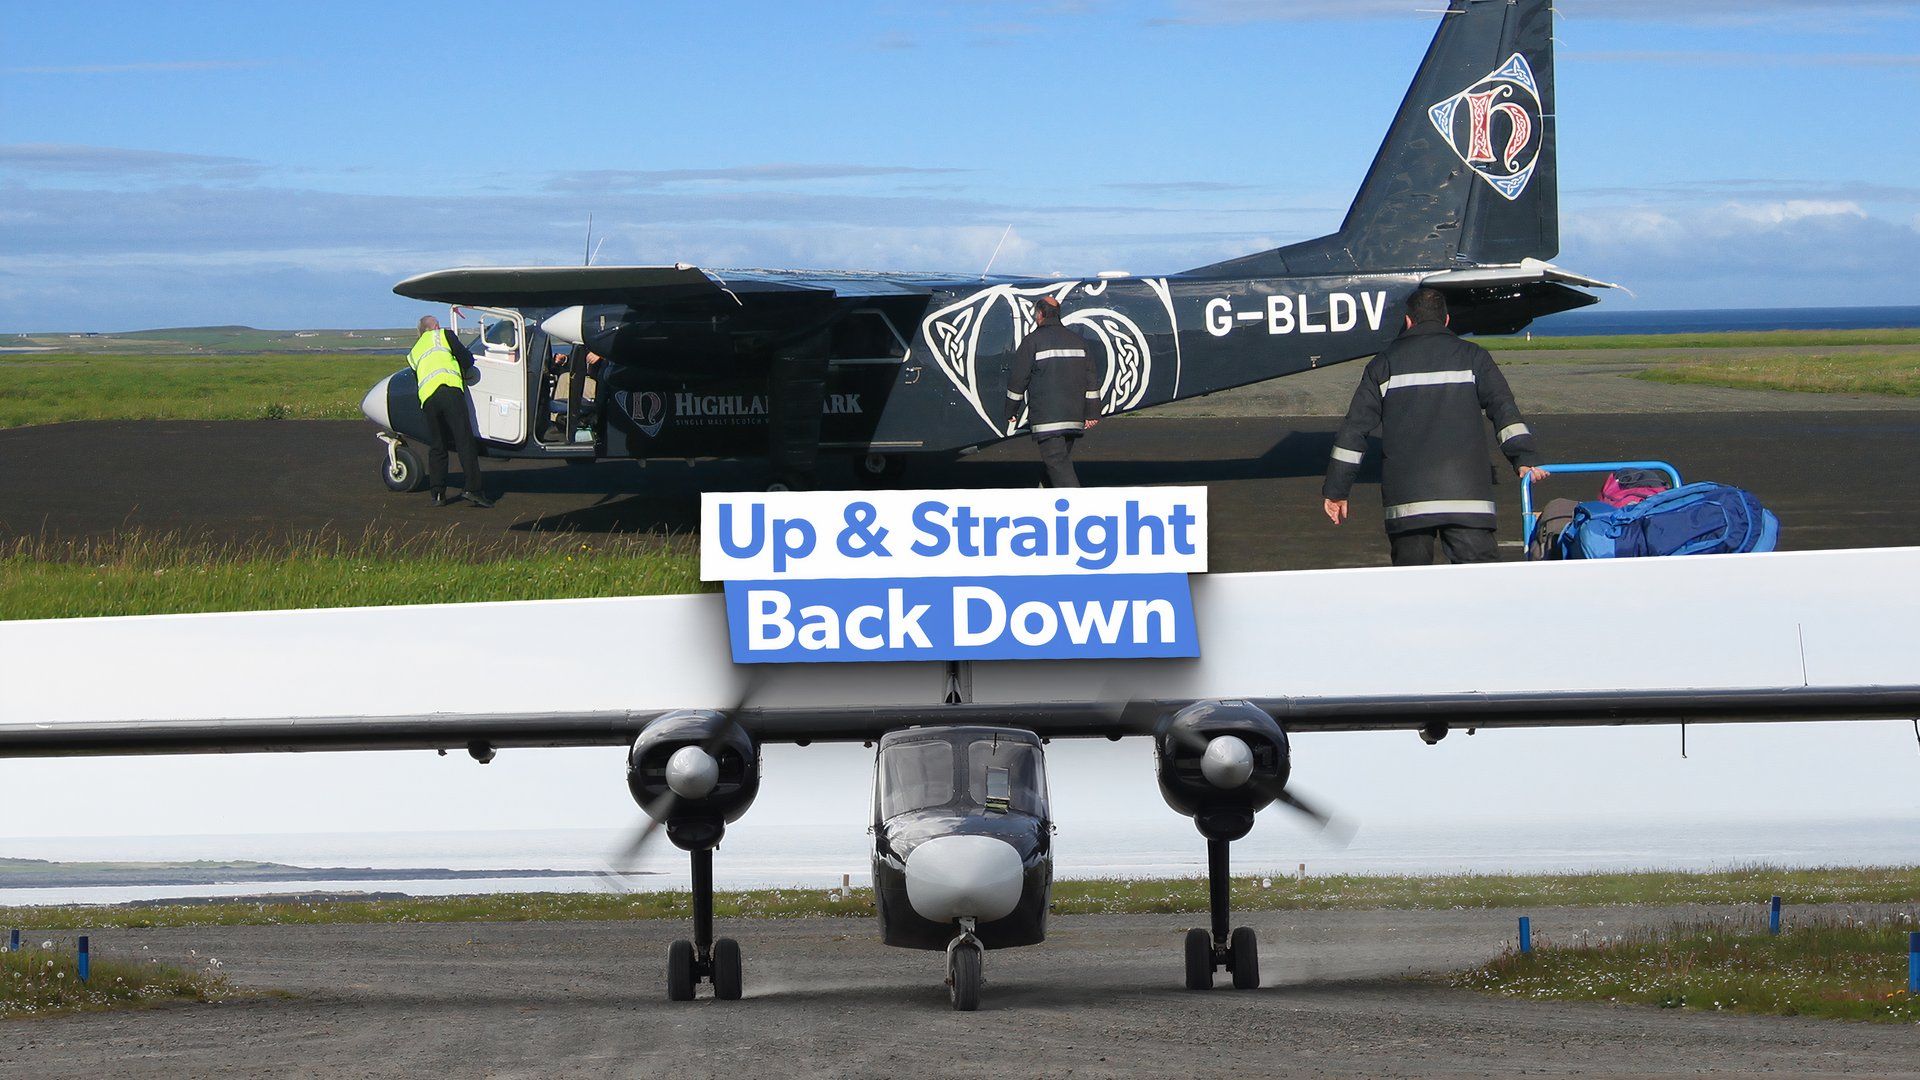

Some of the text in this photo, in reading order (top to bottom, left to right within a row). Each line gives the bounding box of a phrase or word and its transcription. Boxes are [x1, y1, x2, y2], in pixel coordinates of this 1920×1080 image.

[1205, 291, 1387, 337] G-BLDV
[674, 392, 864, 416] HIGHLA ARK
